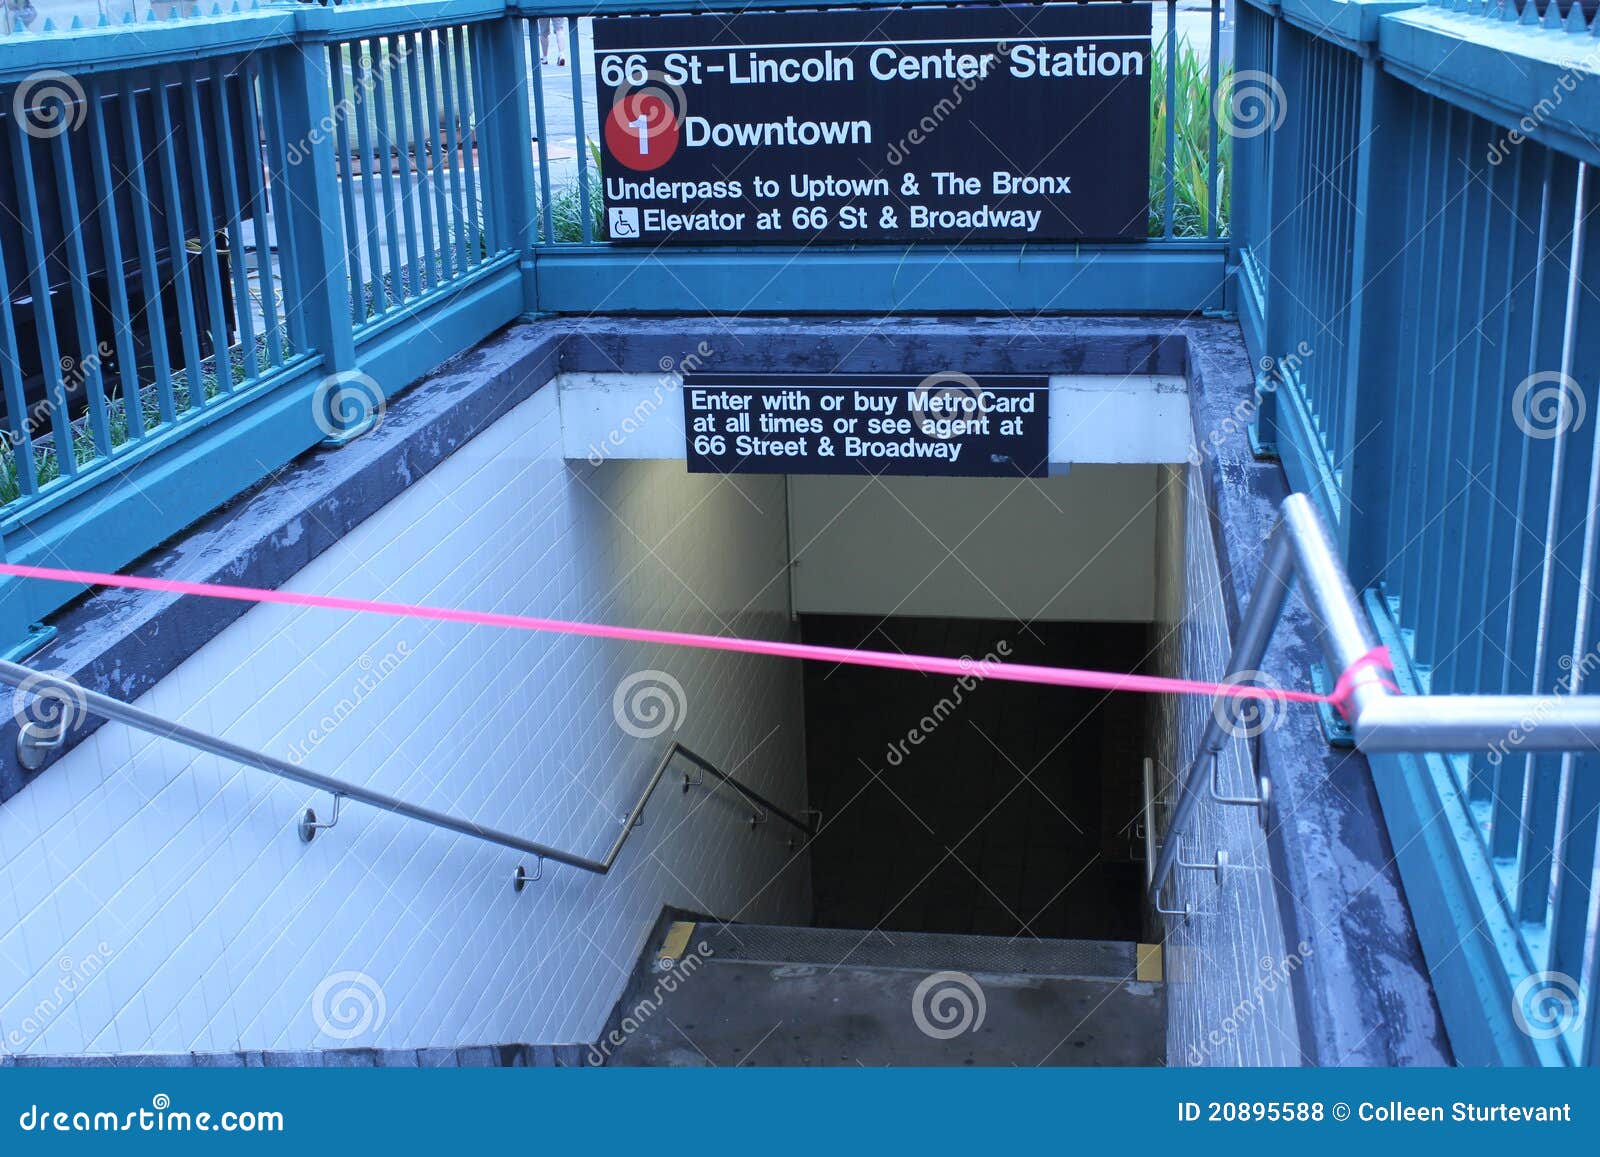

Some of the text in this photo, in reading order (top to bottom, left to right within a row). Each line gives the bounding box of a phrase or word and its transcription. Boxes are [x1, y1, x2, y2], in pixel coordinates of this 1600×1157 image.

[601, 44, 1144, 87] 66 St-Lincoln Center Station
[628, 113, 872, 155] 1 Downtown
[606, 171, 1072, 203] Underpass to Uptown & The Bronx
[643, 204, 1042, 232] Elevator at 66 St & Broadway
[691, 390, 1035, 415] Enter with or buy MetroCard
[693, 413, 1024, 439] at all times or see agent at
[694, 435, 962, 462] 66 Street & Broadway
